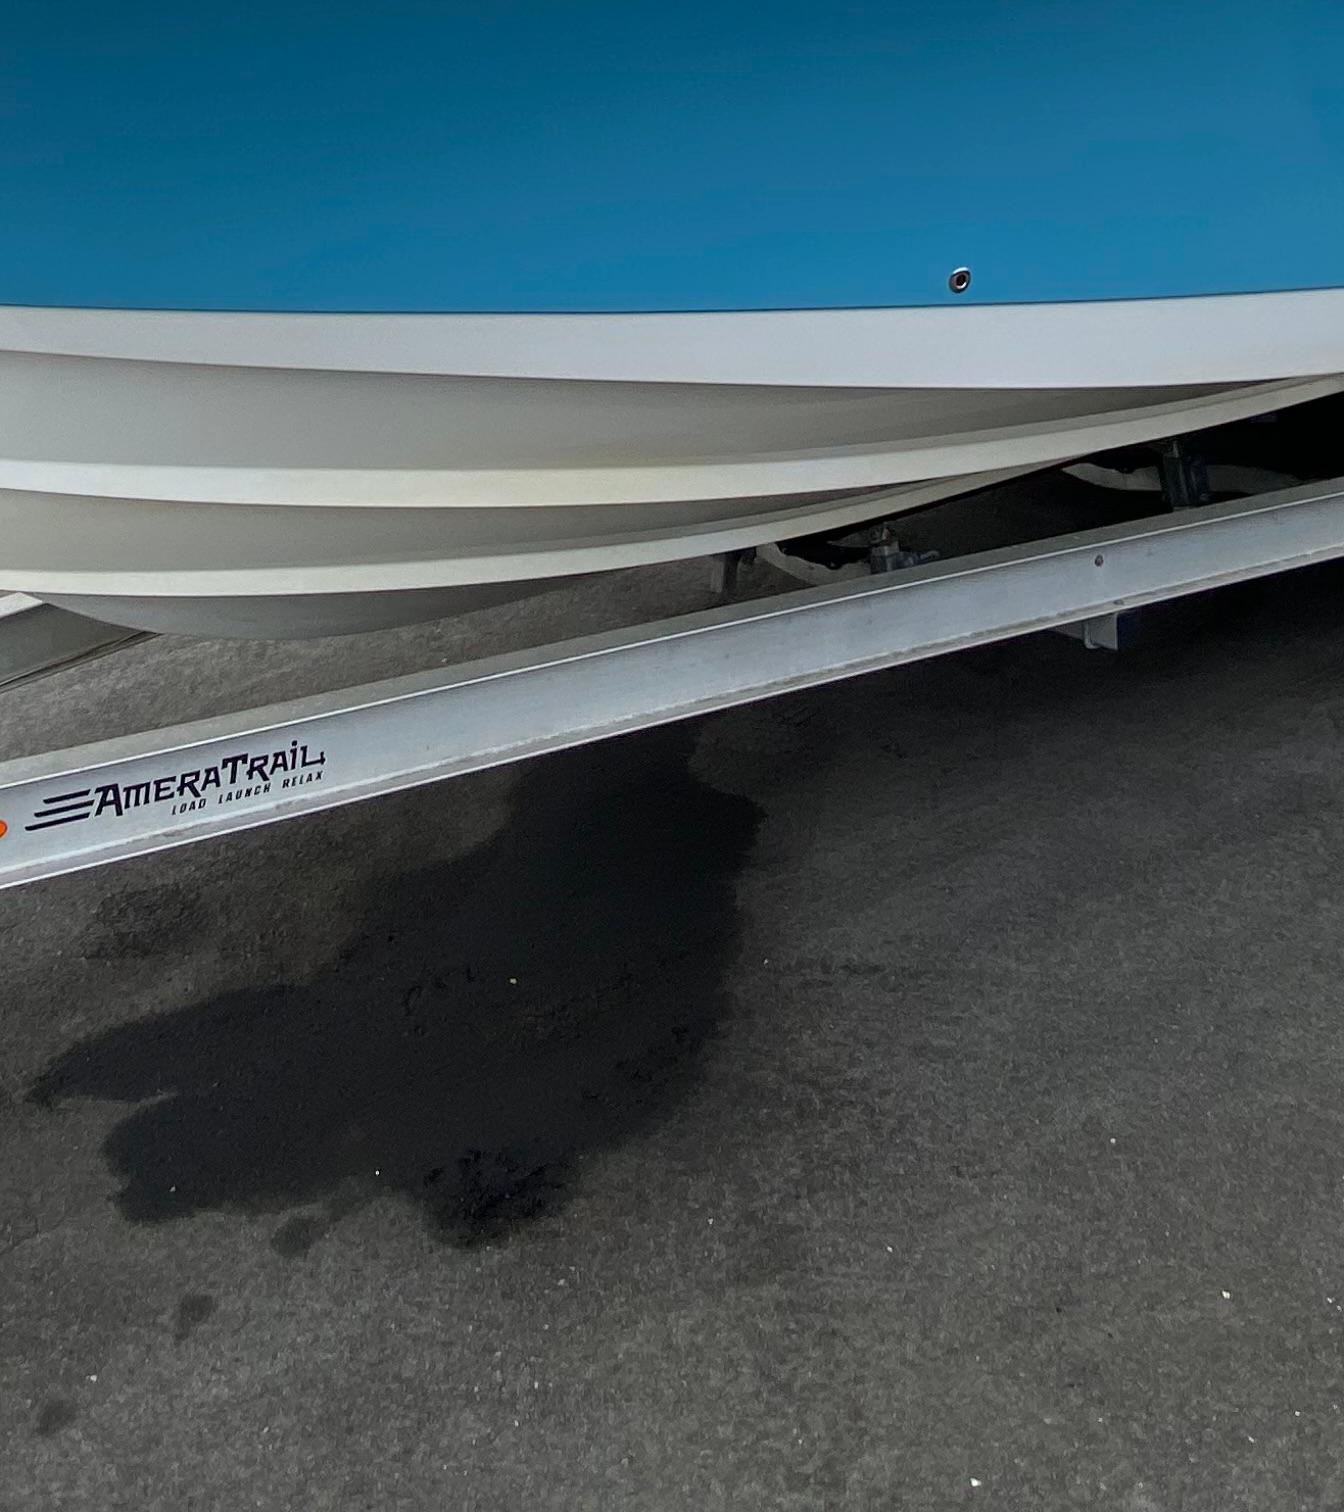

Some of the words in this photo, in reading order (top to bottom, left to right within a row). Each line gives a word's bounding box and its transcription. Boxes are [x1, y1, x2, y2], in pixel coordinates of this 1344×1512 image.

[171, 798, 207, 816] LOAD
[218, 783, 272, 804] LAUNCH
[282, 770, 324, 789] RELAX
